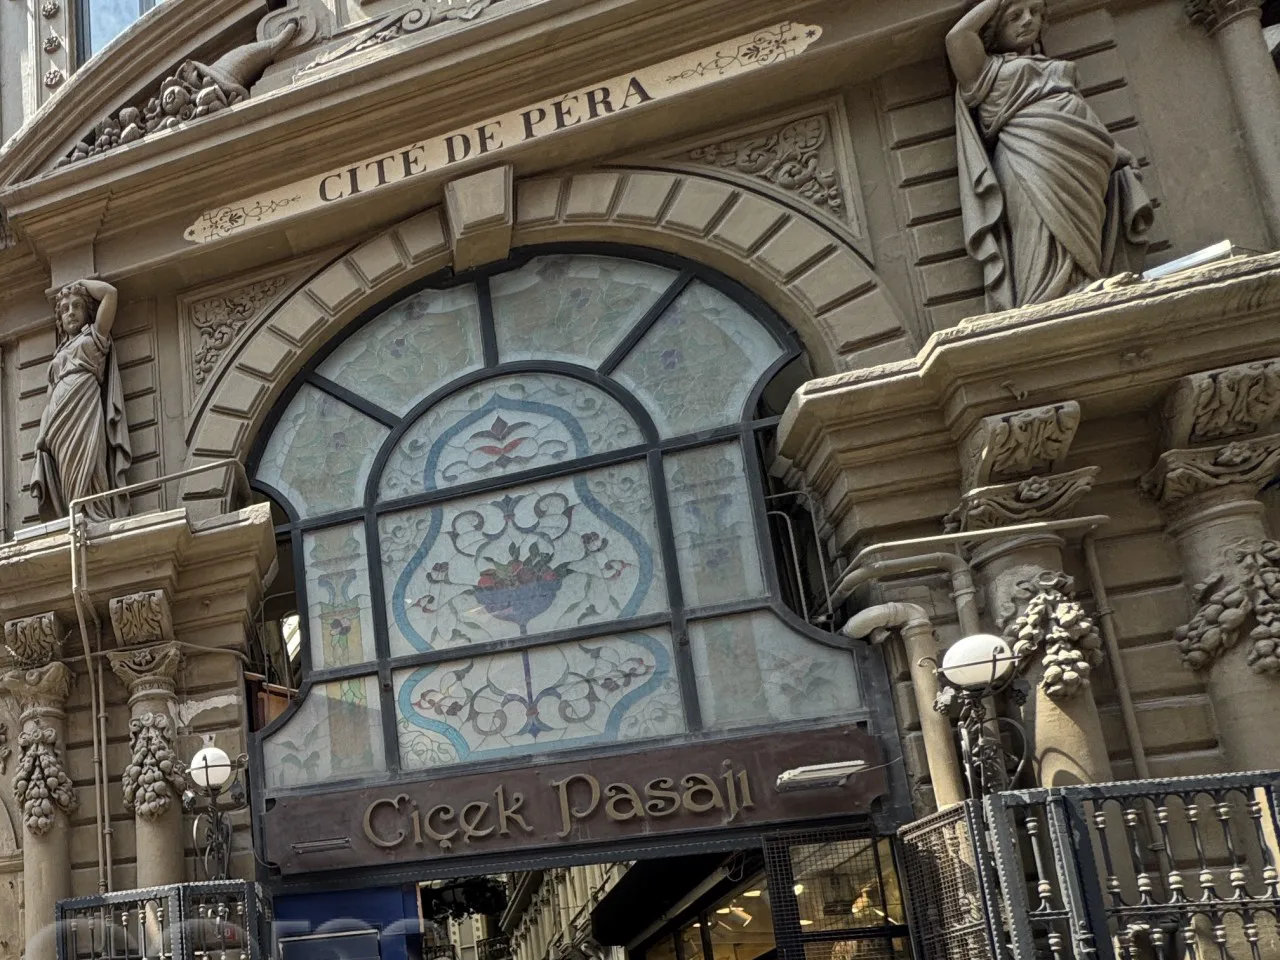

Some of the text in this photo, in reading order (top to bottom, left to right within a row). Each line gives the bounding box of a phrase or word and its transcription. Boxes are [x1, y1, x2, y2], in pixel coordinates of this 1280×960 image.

[319, 76, 654, 203] CITÉ DE PÉRA
